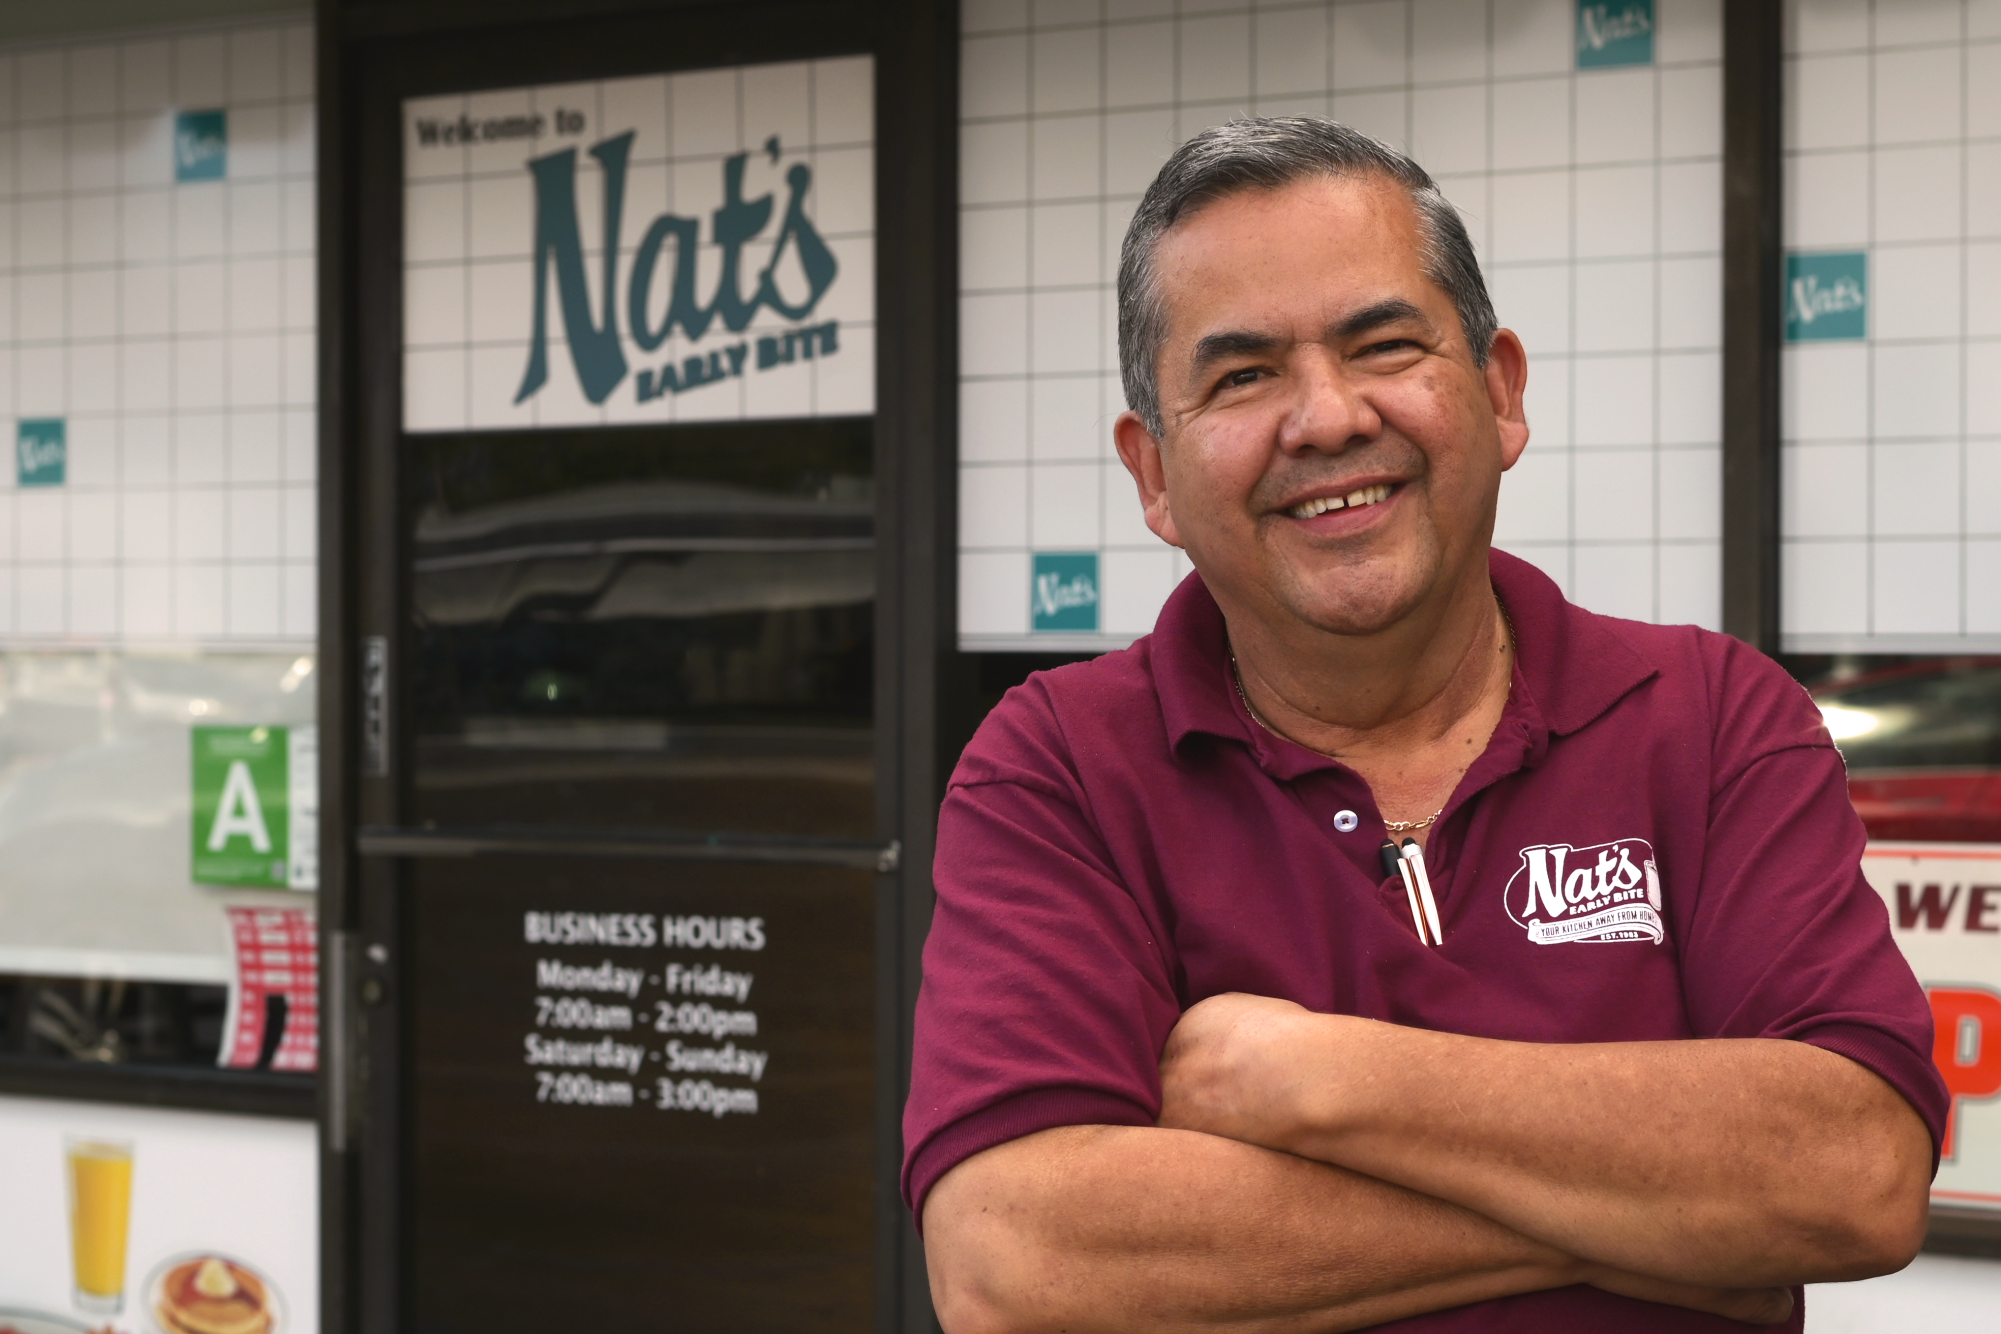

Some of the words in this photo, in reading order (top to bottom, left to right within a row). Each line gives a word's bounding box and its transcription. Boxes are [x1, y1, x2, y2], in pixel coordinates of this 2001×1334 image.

[416, 113, 545, 147] Welcome
[555, 108, 586, 137] to
[513, 128, 839, 406] Nat's
[636, 338, 748, 404] EARLY
[756, 318, 839, 373] BITE
[207, 761, 273, 853] A
[1522, 845, 1643, 917] Nat's
[1569, 895, 1611, 915] EARLY
[1613, 888, 1645, 902] BITE
[524, 911, 657, 947] BUSINESS
[663, 914, 766, 950] HOURS
[1540, 926, 1560, 937] YOUR
[1562, 920, 1593, 933] KITCHEN
[1595, 914, 1615, 926] AWAY
[1617, 910, 1637, 921] FROM
[1893, 882, 2001, 933] WE
[537, 959, 645, 1000] Monday
[666, 963, 753, 1004] Friday
[535, 996, 632, 1031] 7:00am
[654, 1000, 757, 1041] 2:00pm
[524, 1032, 645, 1076] Saturday
[665, 1039, 768, 1082] Sunday
[535, 1071, 633, 1107] 7:00am
[655, 1077, 758, 1118] 3:00pm
